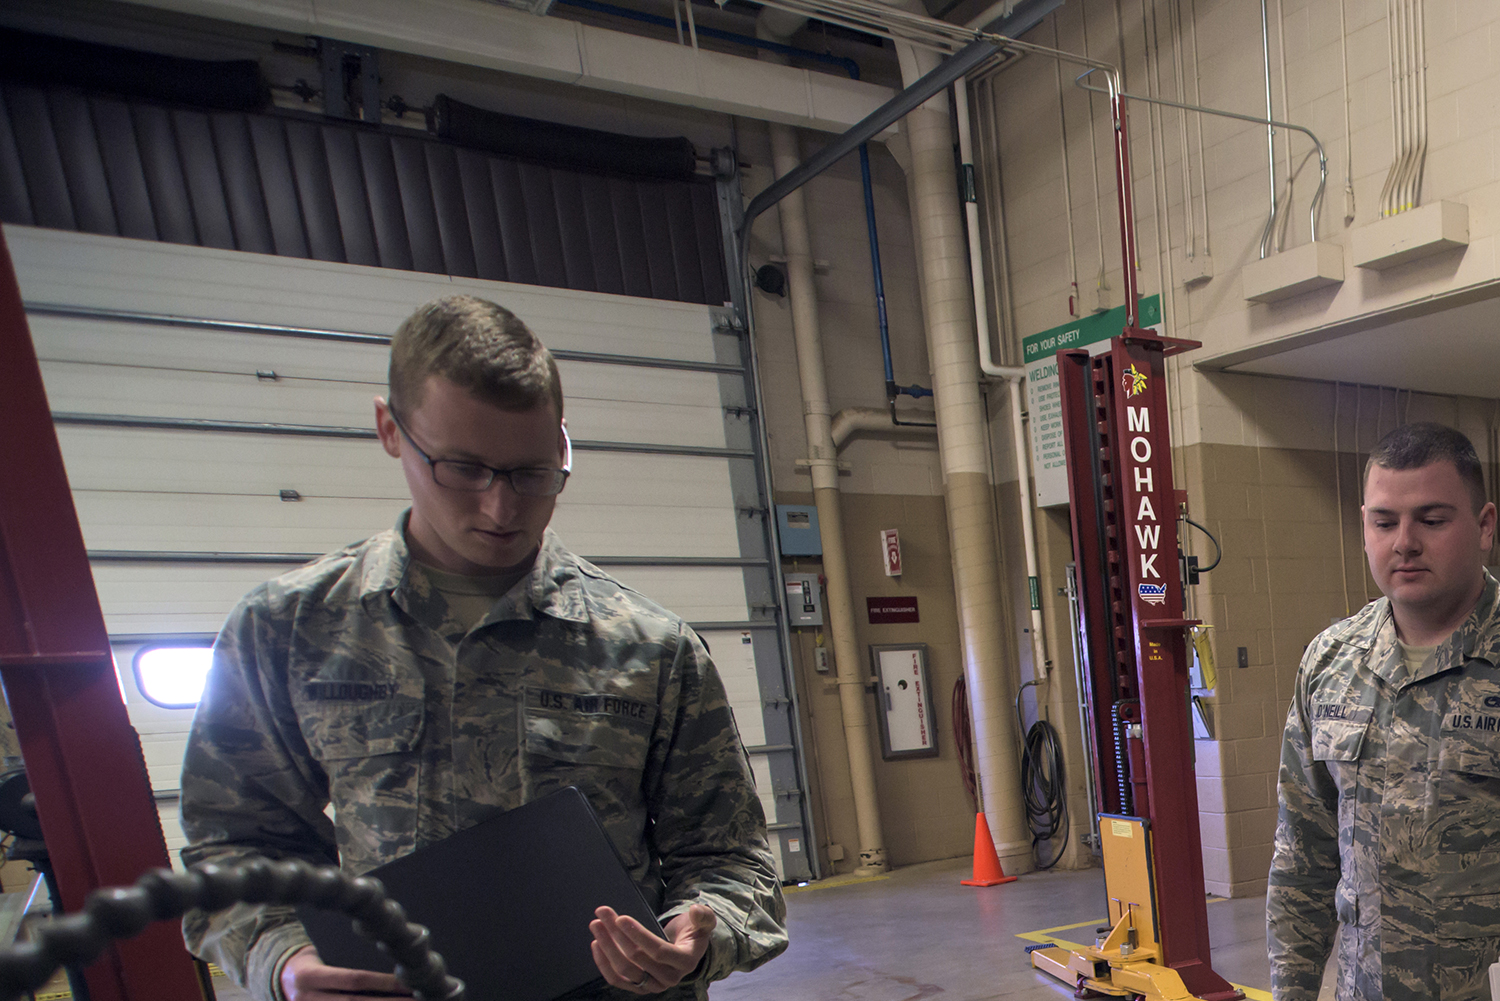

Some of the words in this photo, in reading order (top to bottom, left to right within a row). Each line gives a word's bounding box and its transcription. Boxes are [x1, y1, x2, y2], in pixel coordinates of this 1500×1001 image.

[1026, 343, 1039, 355] FOR
[1040, 337, 1056, 351] YOUR
[1057, 329, 1080, 346] SAFETY
[1126, 406, 1161, 579] MOHAWK
[603, 697, 647, 719] FORCE
[915, 680, 927, 745] EXTINGUISHER
[1316, 704, 1346, 718] O'NEILL
[1452, 716, 1473, 730] U.S.
[1477, 717, 1498, 733] AIR
